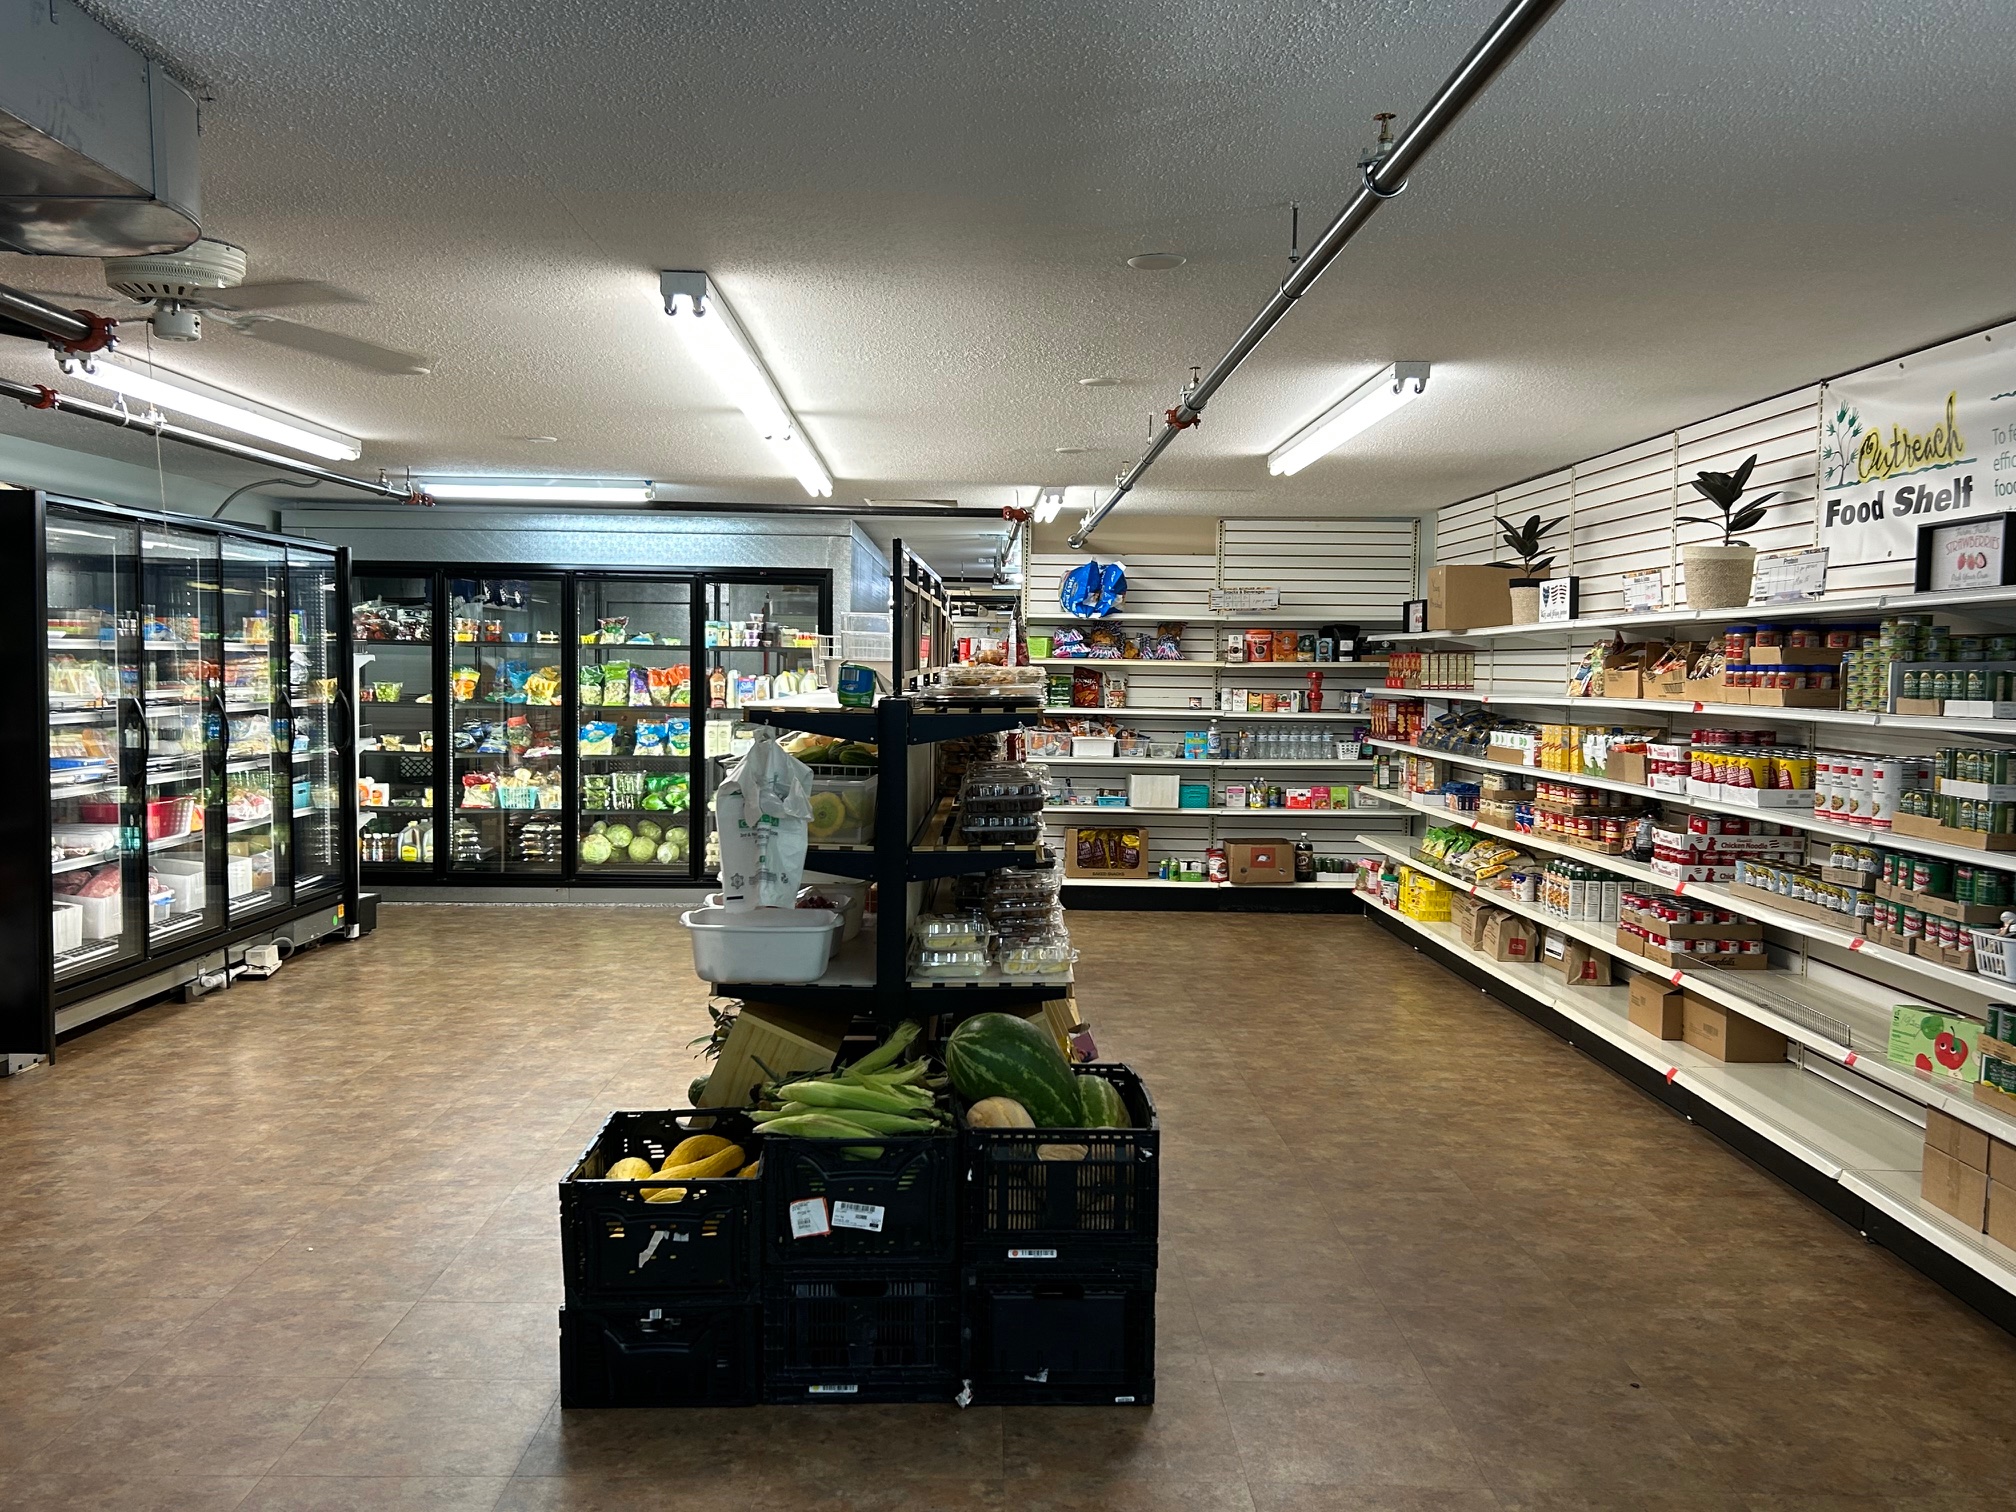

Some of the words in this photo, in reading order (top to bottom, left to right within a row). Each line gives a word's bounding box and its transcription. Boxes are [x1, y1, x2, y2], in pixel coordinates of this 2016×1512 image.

[1858, 394, 1964, 479] Outreach
[1992, 427, 2006, 446] To
[1825, 489, 1886, 529] Food
[1892, 475, 1974, 518] Shelf
[1945, 535, 2000, 555] STRAWBERRIES
[741, 681, 753, 690] Silk
[1720, 841, 1745, 850] Chicken
[1745, 841, 1768, 850] Noodle
